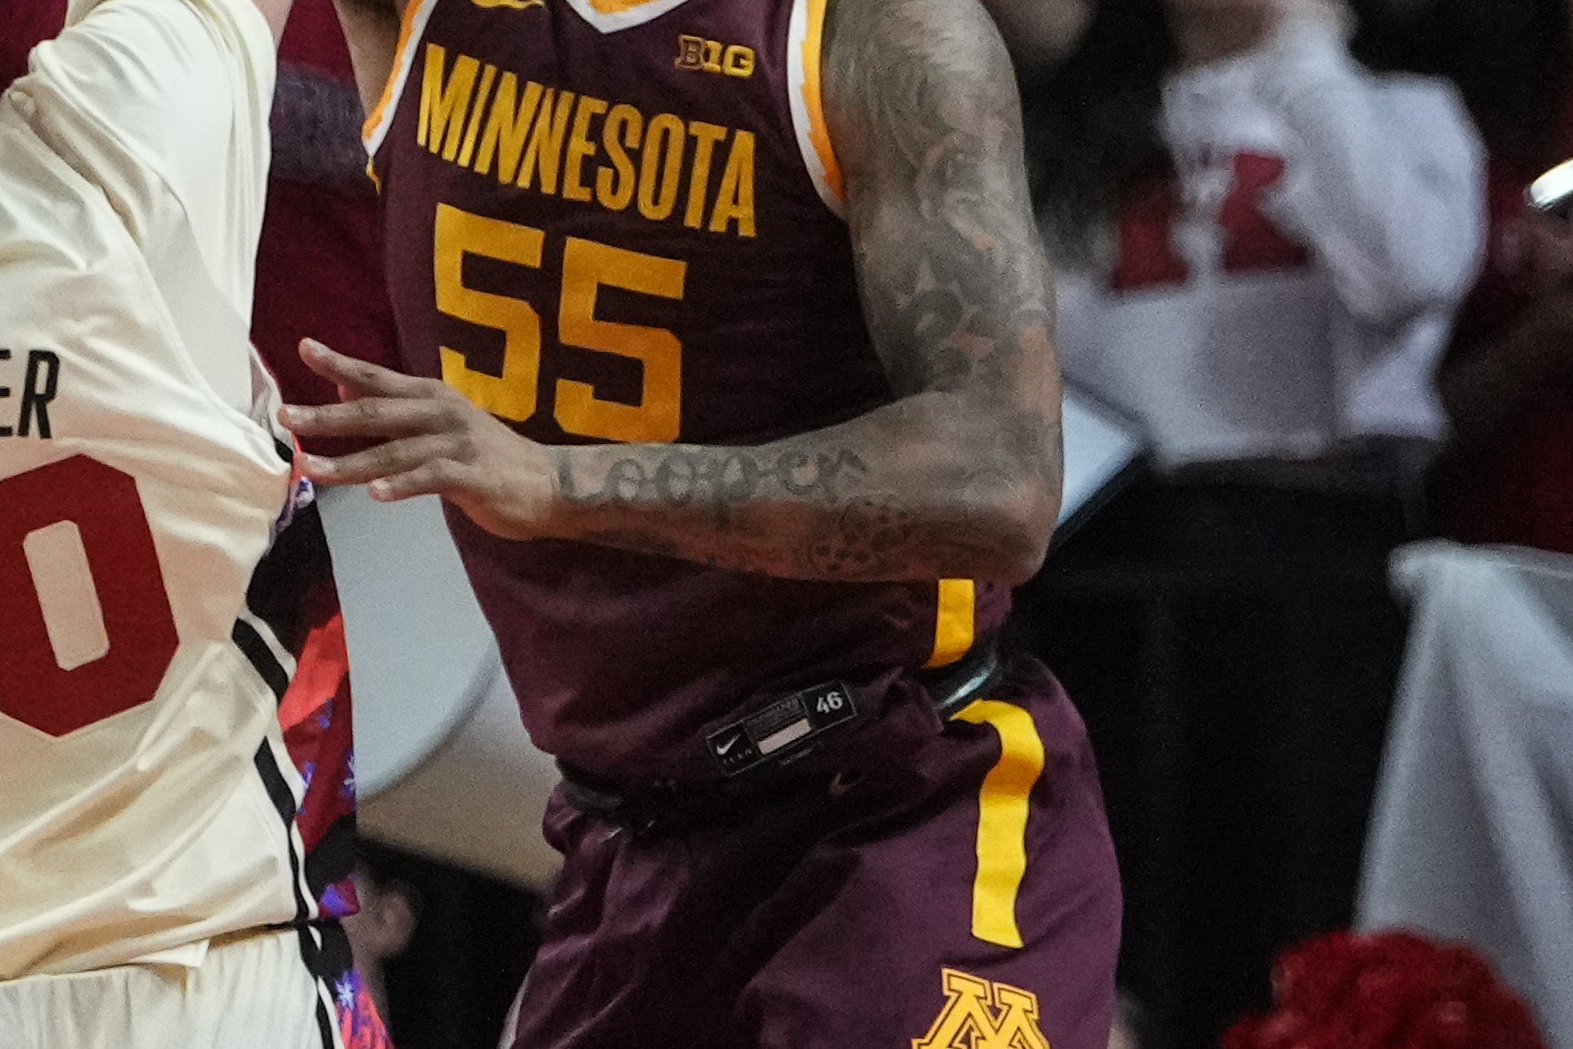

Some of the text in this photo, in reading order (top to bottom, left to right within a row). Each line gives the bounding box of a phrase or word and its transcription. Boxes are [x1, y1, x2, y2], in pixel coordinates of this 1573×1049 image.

[417, 43, 756, 238] MINNESOTA
[433, 202, 688, 444] 55
[816, 691, 844, 714] 46
